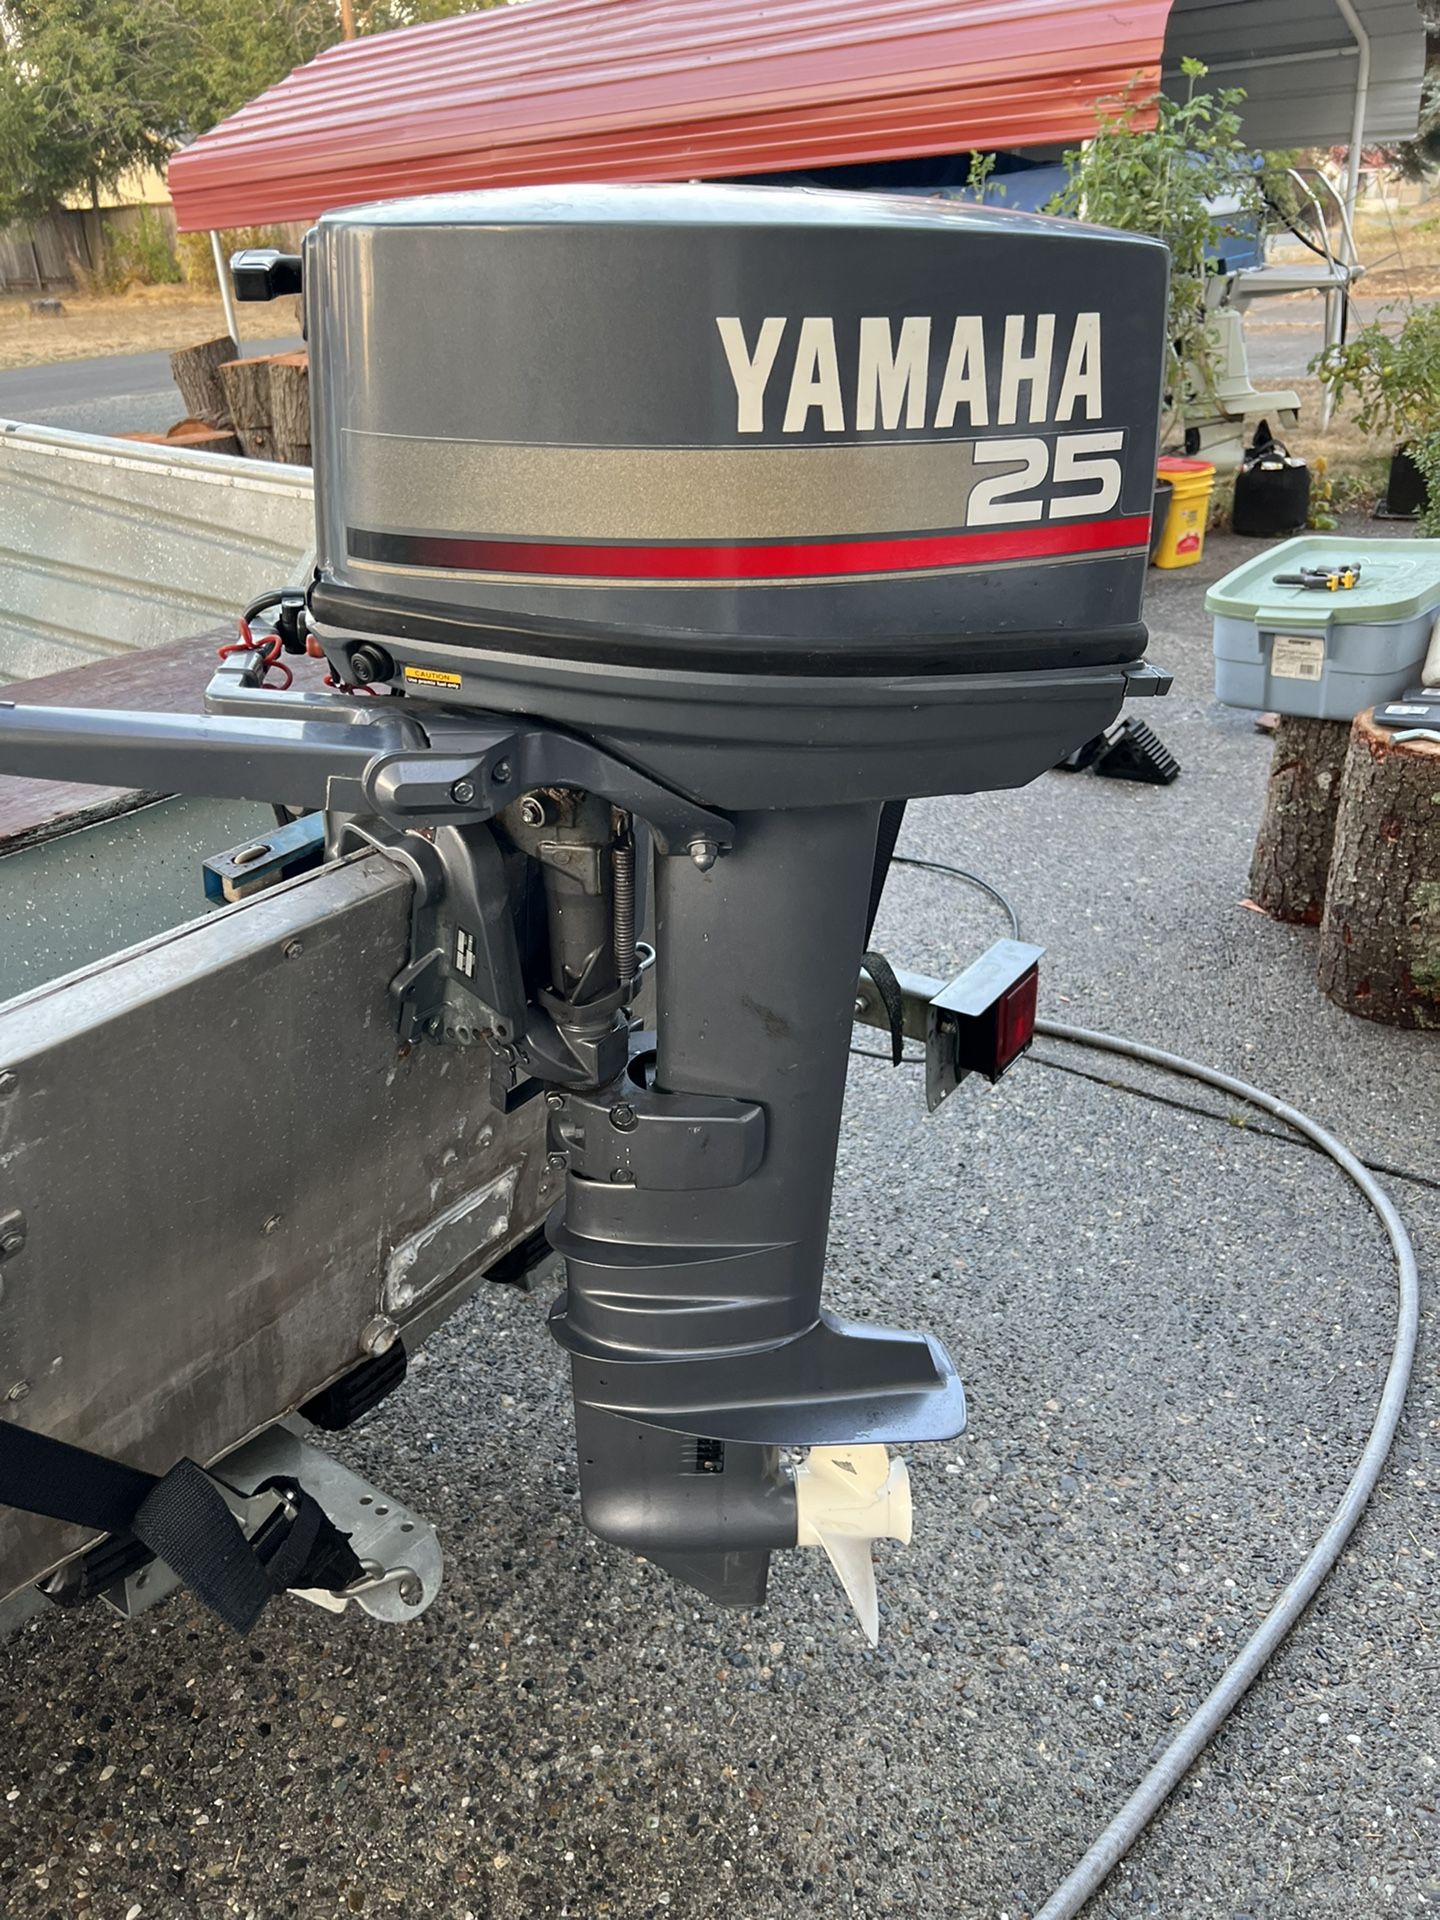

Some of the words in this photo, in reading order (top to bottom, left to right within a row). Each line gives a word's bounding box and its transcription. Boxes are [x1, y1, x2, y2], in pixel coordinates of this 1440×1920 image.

[716, 312, 1102, 432] YAMAHA
[966, 431, 1124, 526] 25
[414, 670, 450, 681] CAUTION
